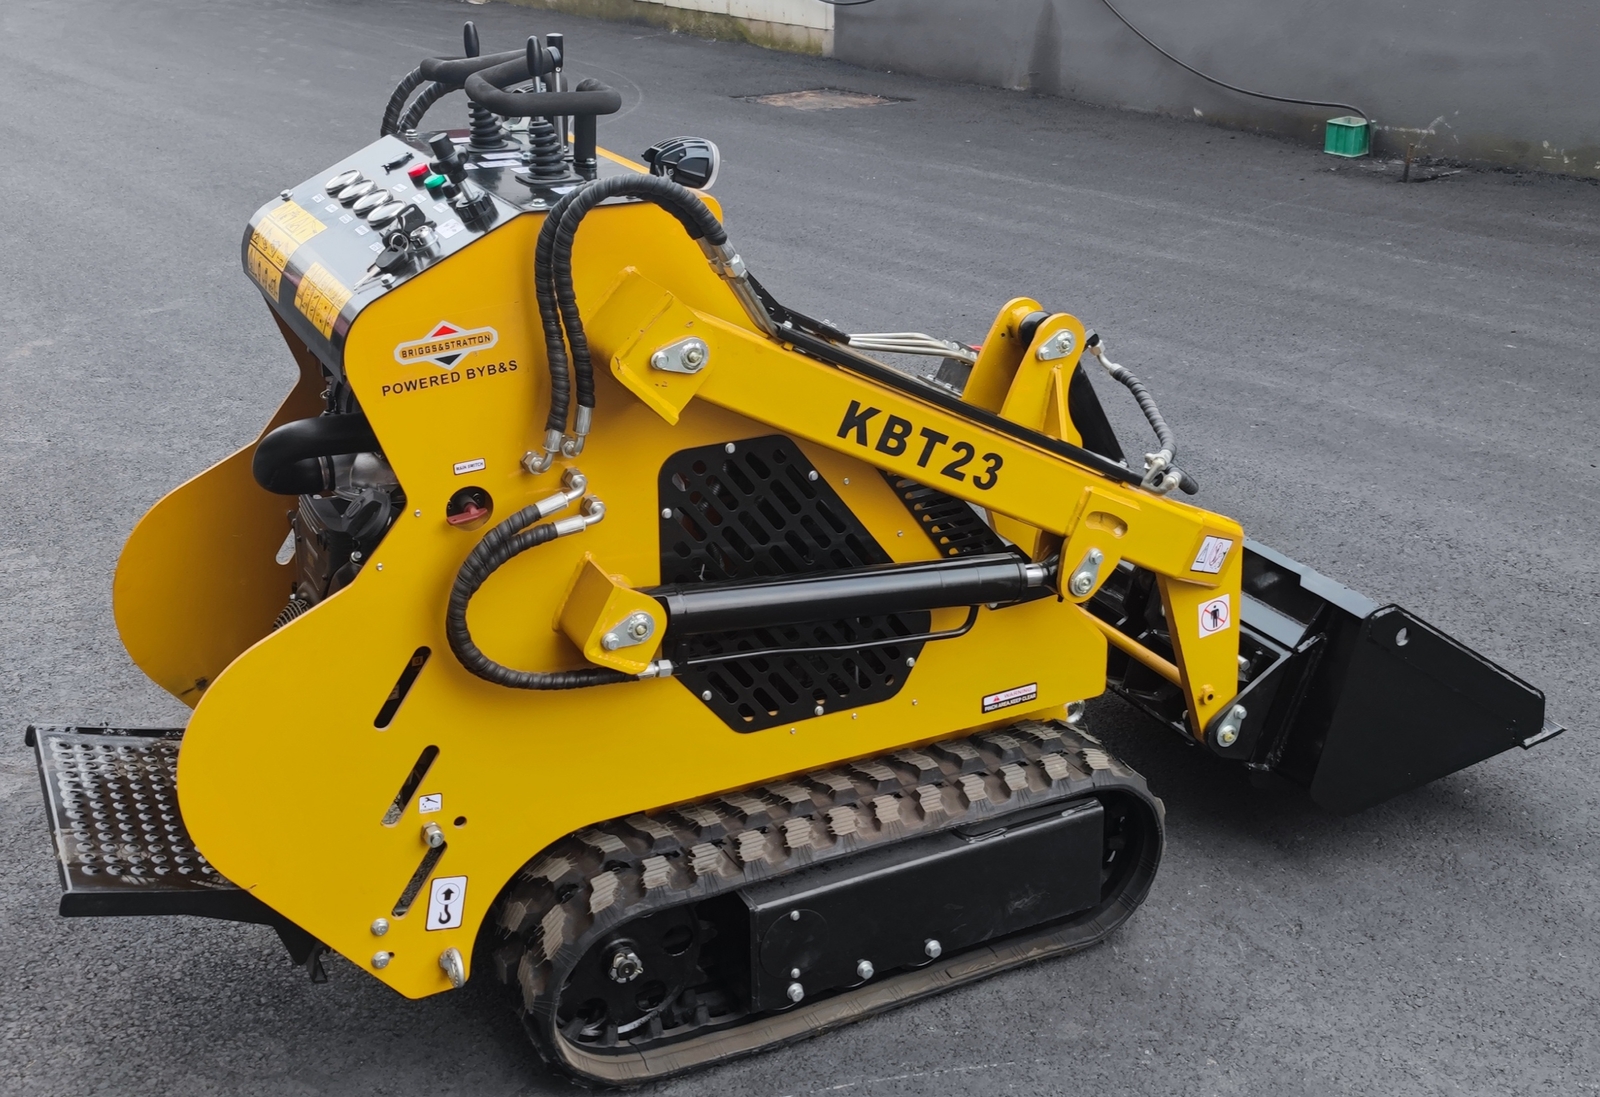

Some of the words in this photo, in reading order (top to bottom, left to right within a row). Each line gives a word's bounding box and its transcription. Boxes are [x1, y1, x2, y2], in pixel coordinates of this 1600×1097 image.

[401, 334, 491, 358] BRIGGS&STRATTON
[382, 371, 461, 396] POWERED
[836, 399, 1003, 490] KBT23
[1004, 687, 1032, 698] WARNING
